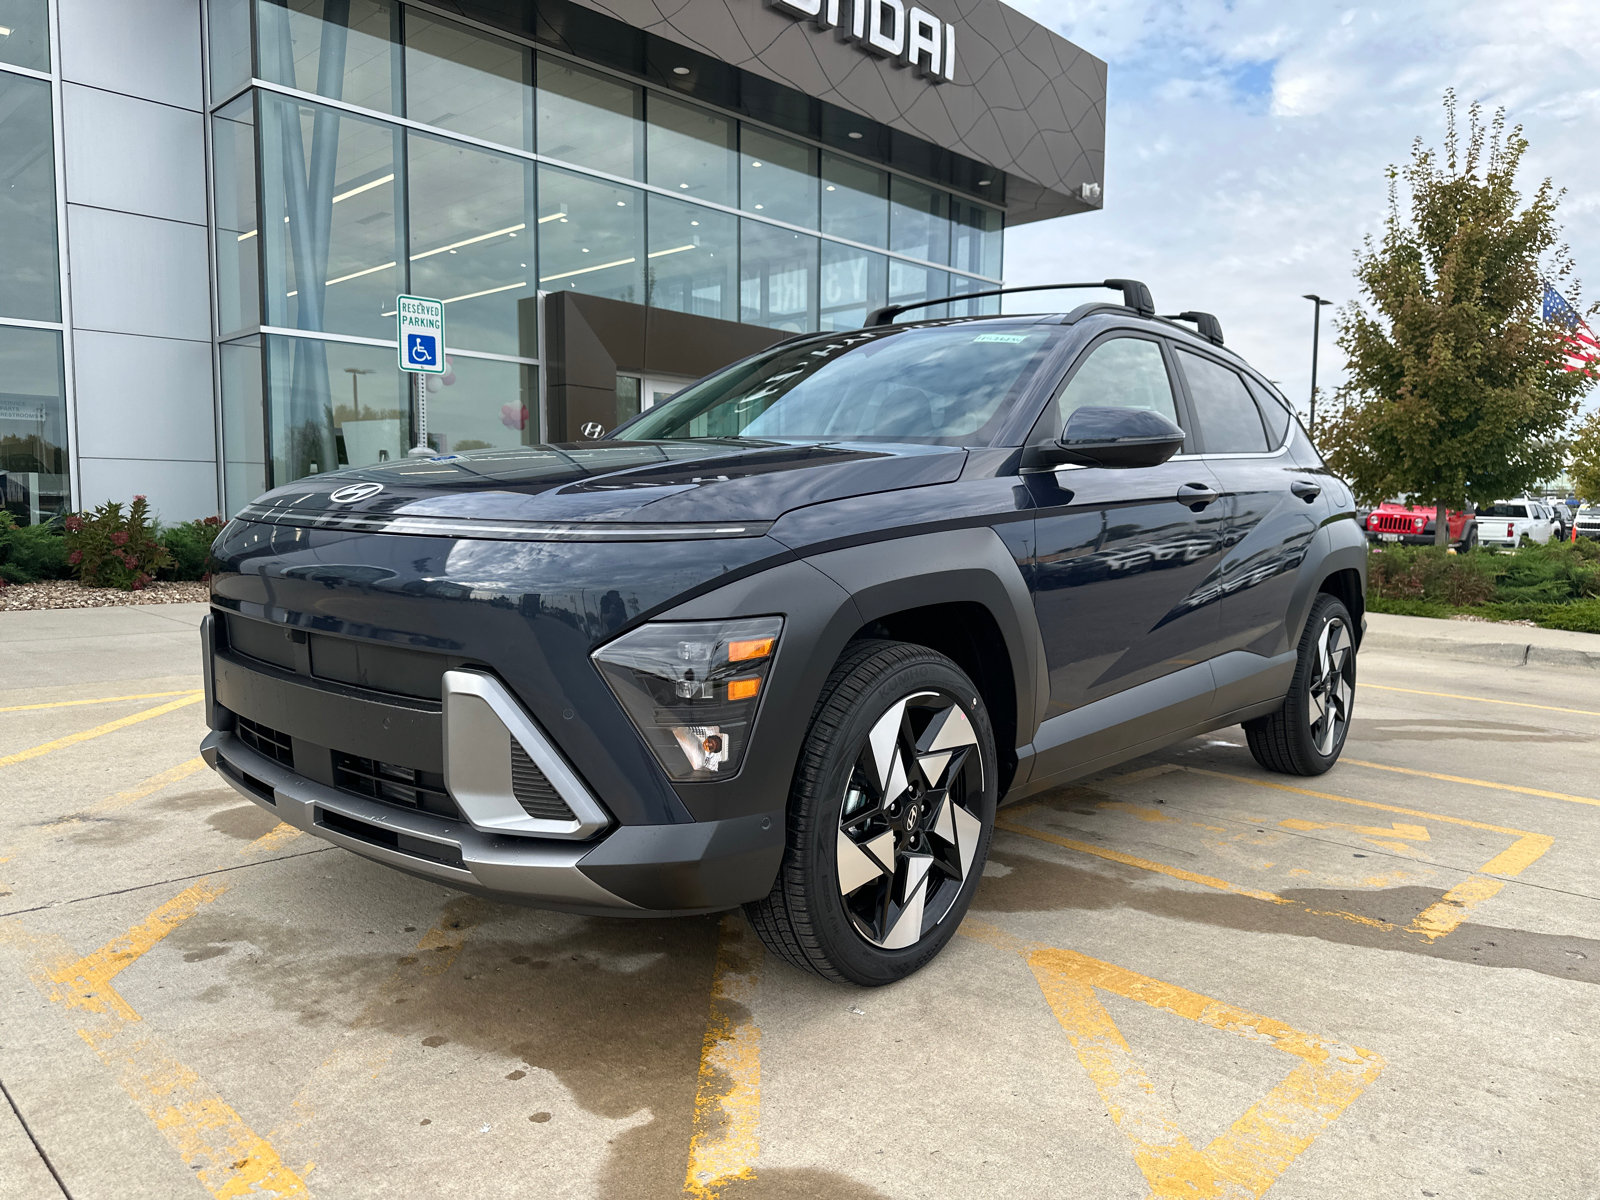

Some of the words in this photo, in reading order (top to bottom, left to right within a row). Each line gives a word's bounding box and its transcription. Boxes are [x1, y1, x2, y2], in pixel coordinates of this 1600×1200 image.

[772, 0, 955, 81] NDAI
[402, 302, 439, 316] RESERVED
[402, 315, 439, 329] PARKING
[878, 666, 929, 700] KUMHO
